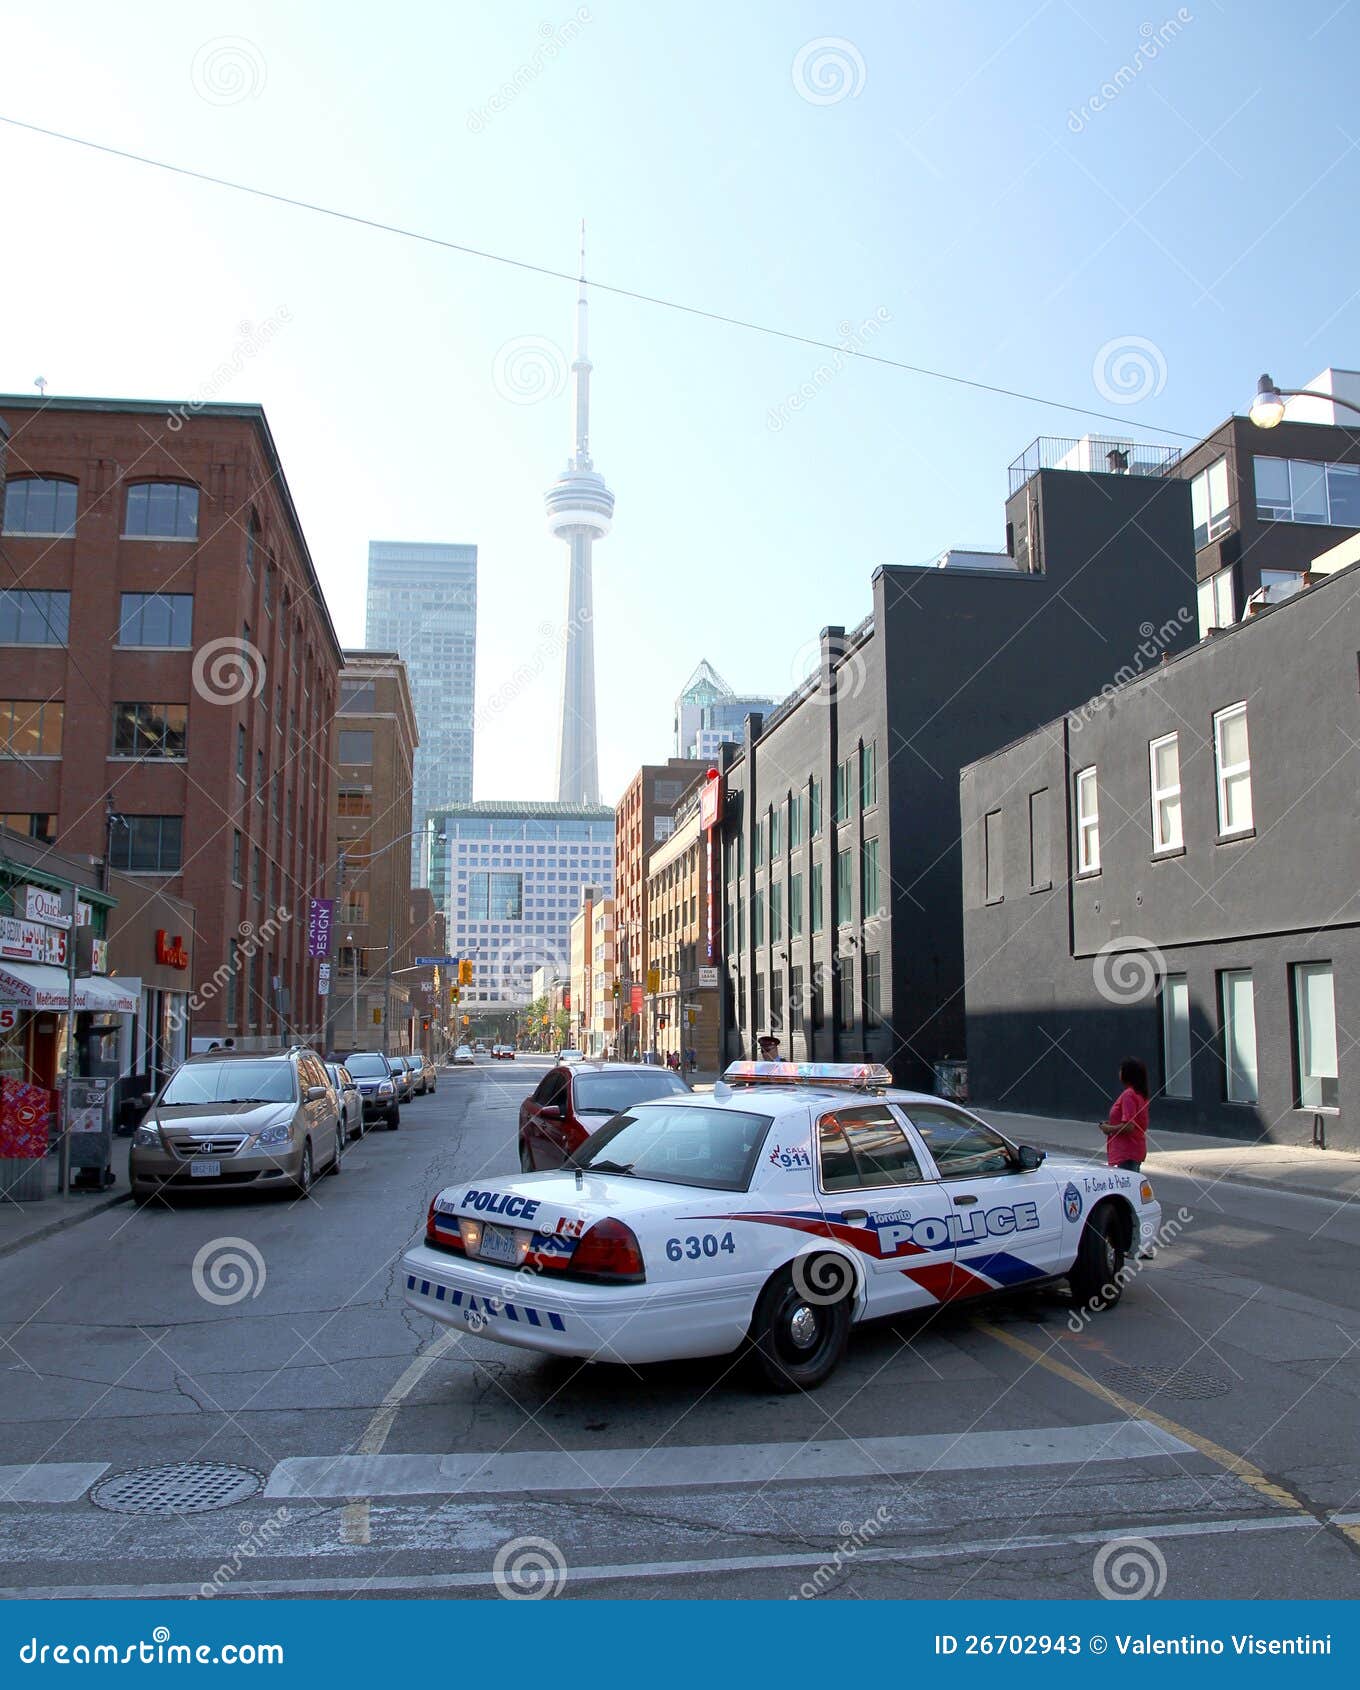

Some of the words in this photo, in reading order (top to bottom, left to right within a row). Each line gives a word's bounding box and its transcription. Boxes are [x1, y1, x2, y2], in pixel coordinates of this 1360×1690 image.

[316, 909, 329, 955] DESIGN
[461, 1190, 541, 1220] POLICE
[870, 1209, 911, 1224] Toronto
[877, 1202, 1040, 1254] POLICE
[665, 1232, 735, 1261] 6304
